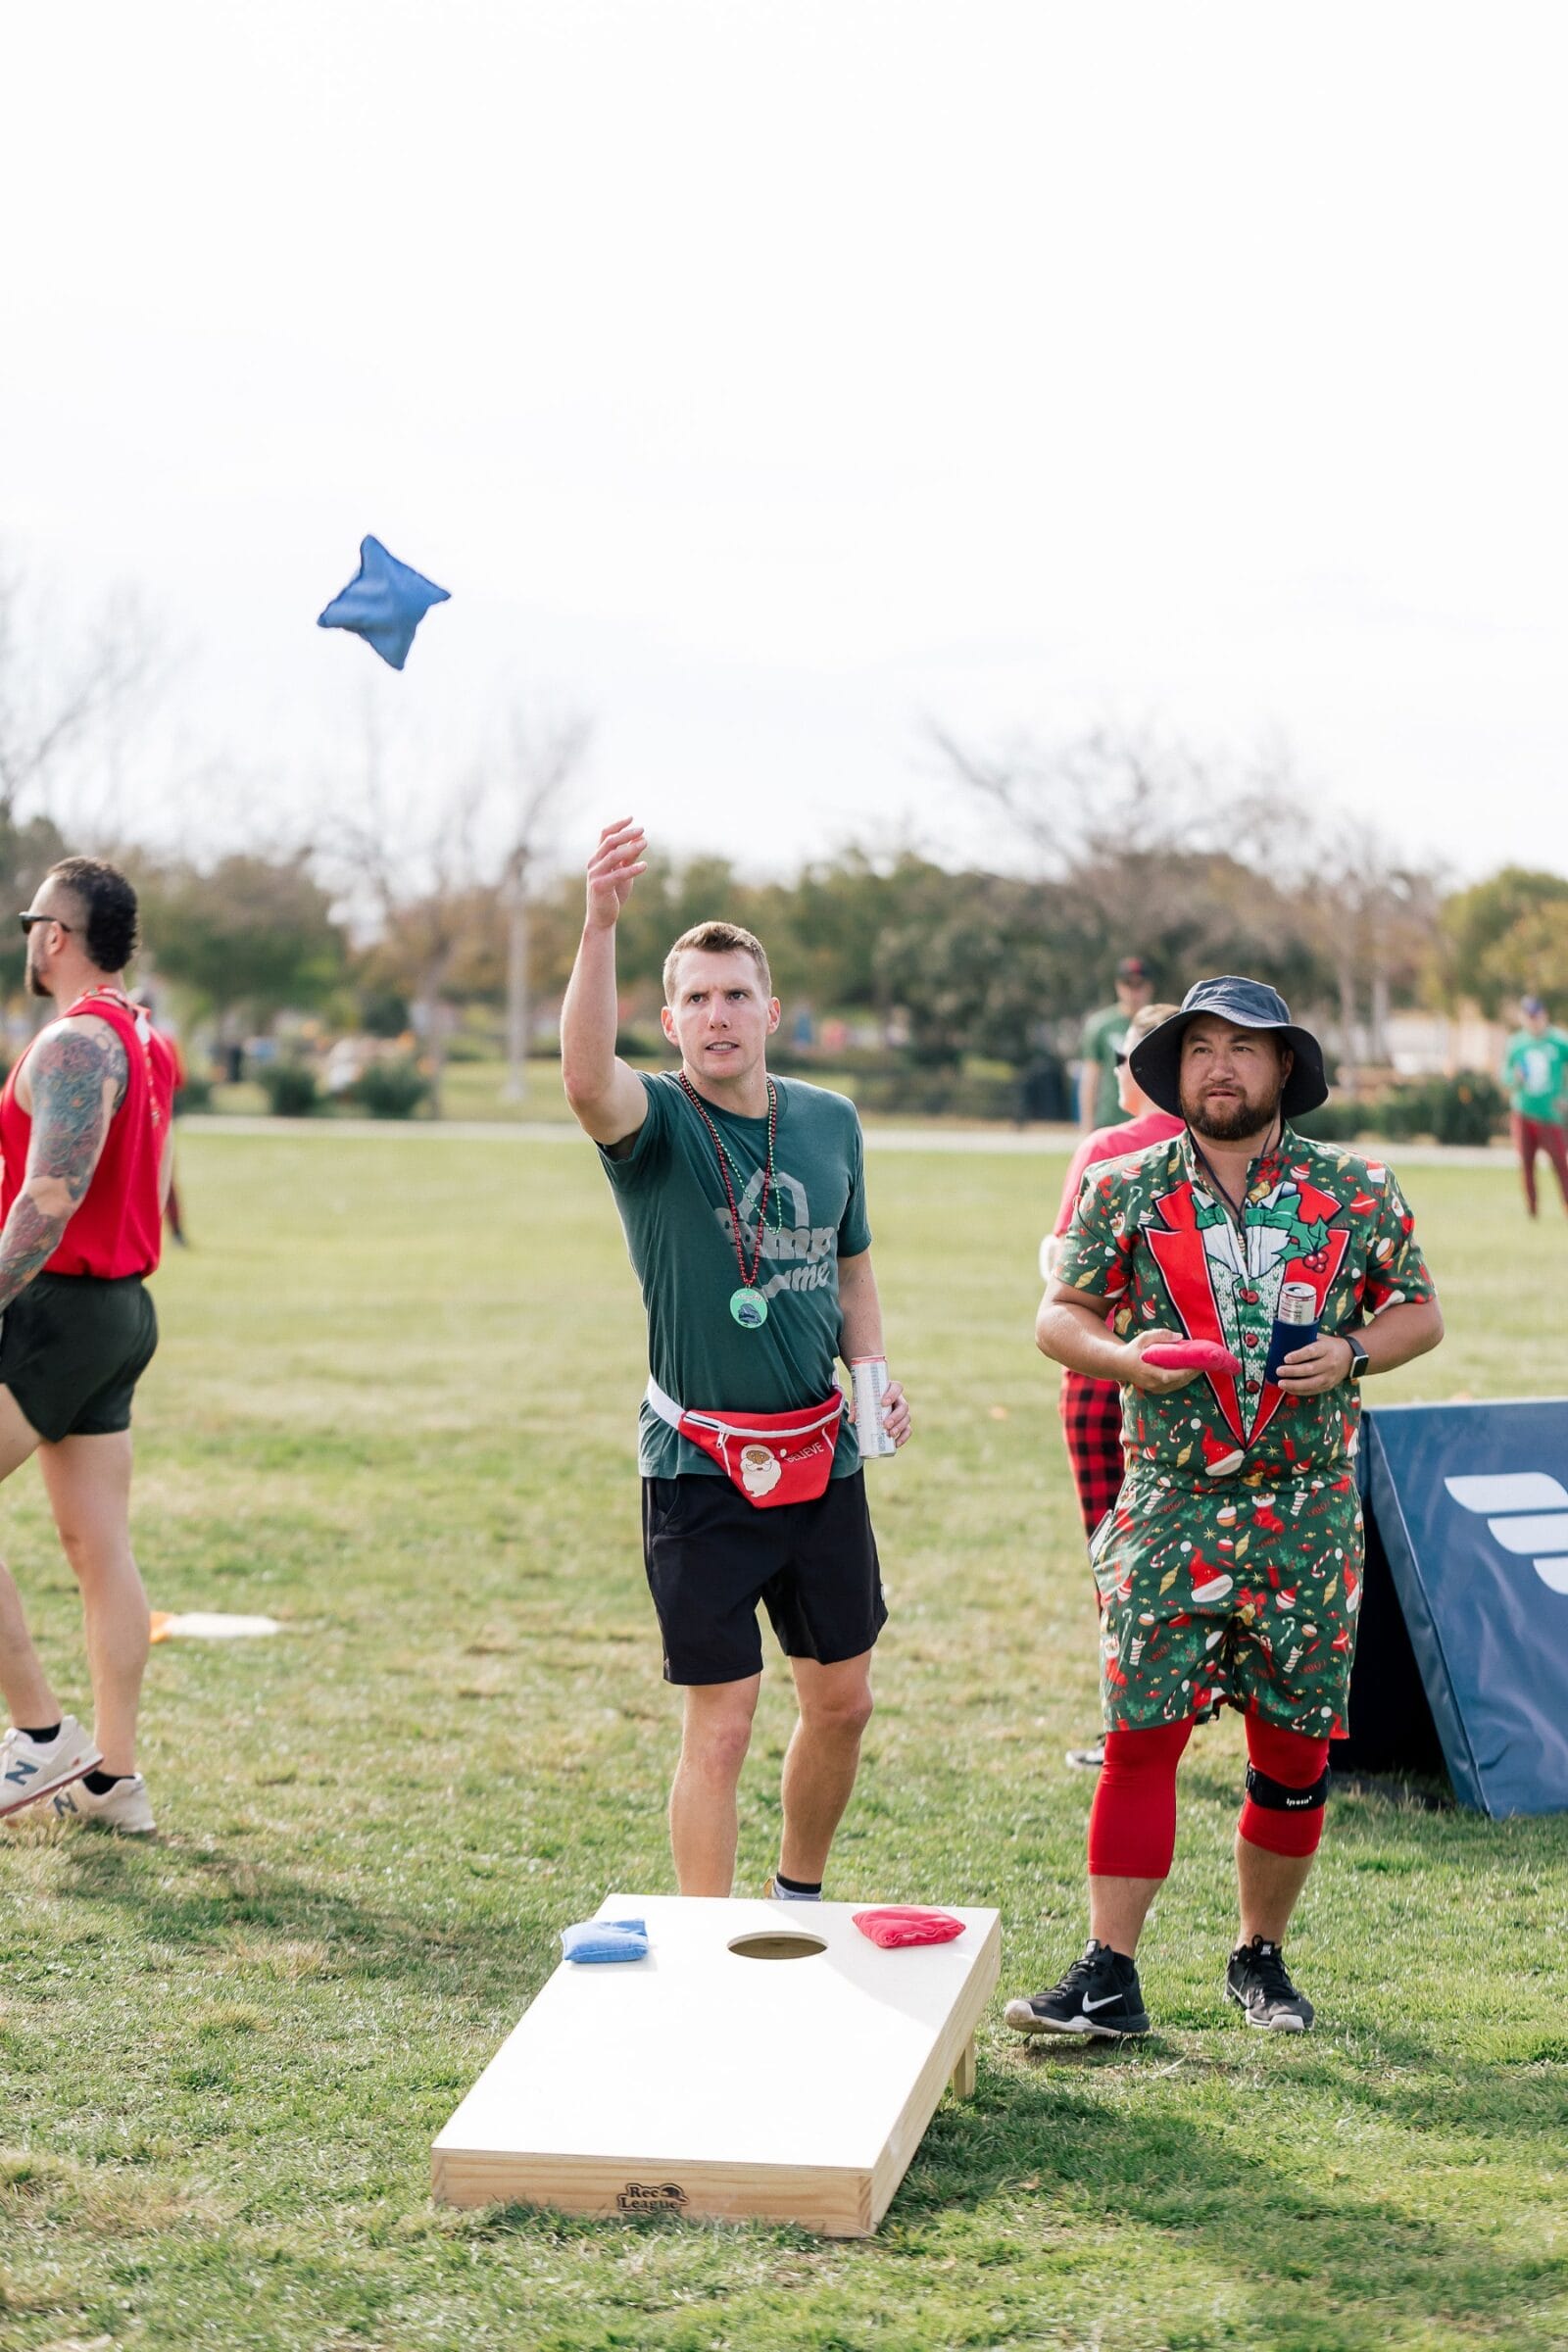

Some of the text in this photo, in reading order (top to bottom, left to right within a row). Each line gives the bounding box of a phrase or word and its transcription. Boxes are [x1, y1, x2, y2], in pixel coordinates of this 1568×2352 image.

[783, 1442, 825, 1464] BELIEVE
[629, 2186, 660, 2198] Rec
[620, 2197, 678, 2212] League
